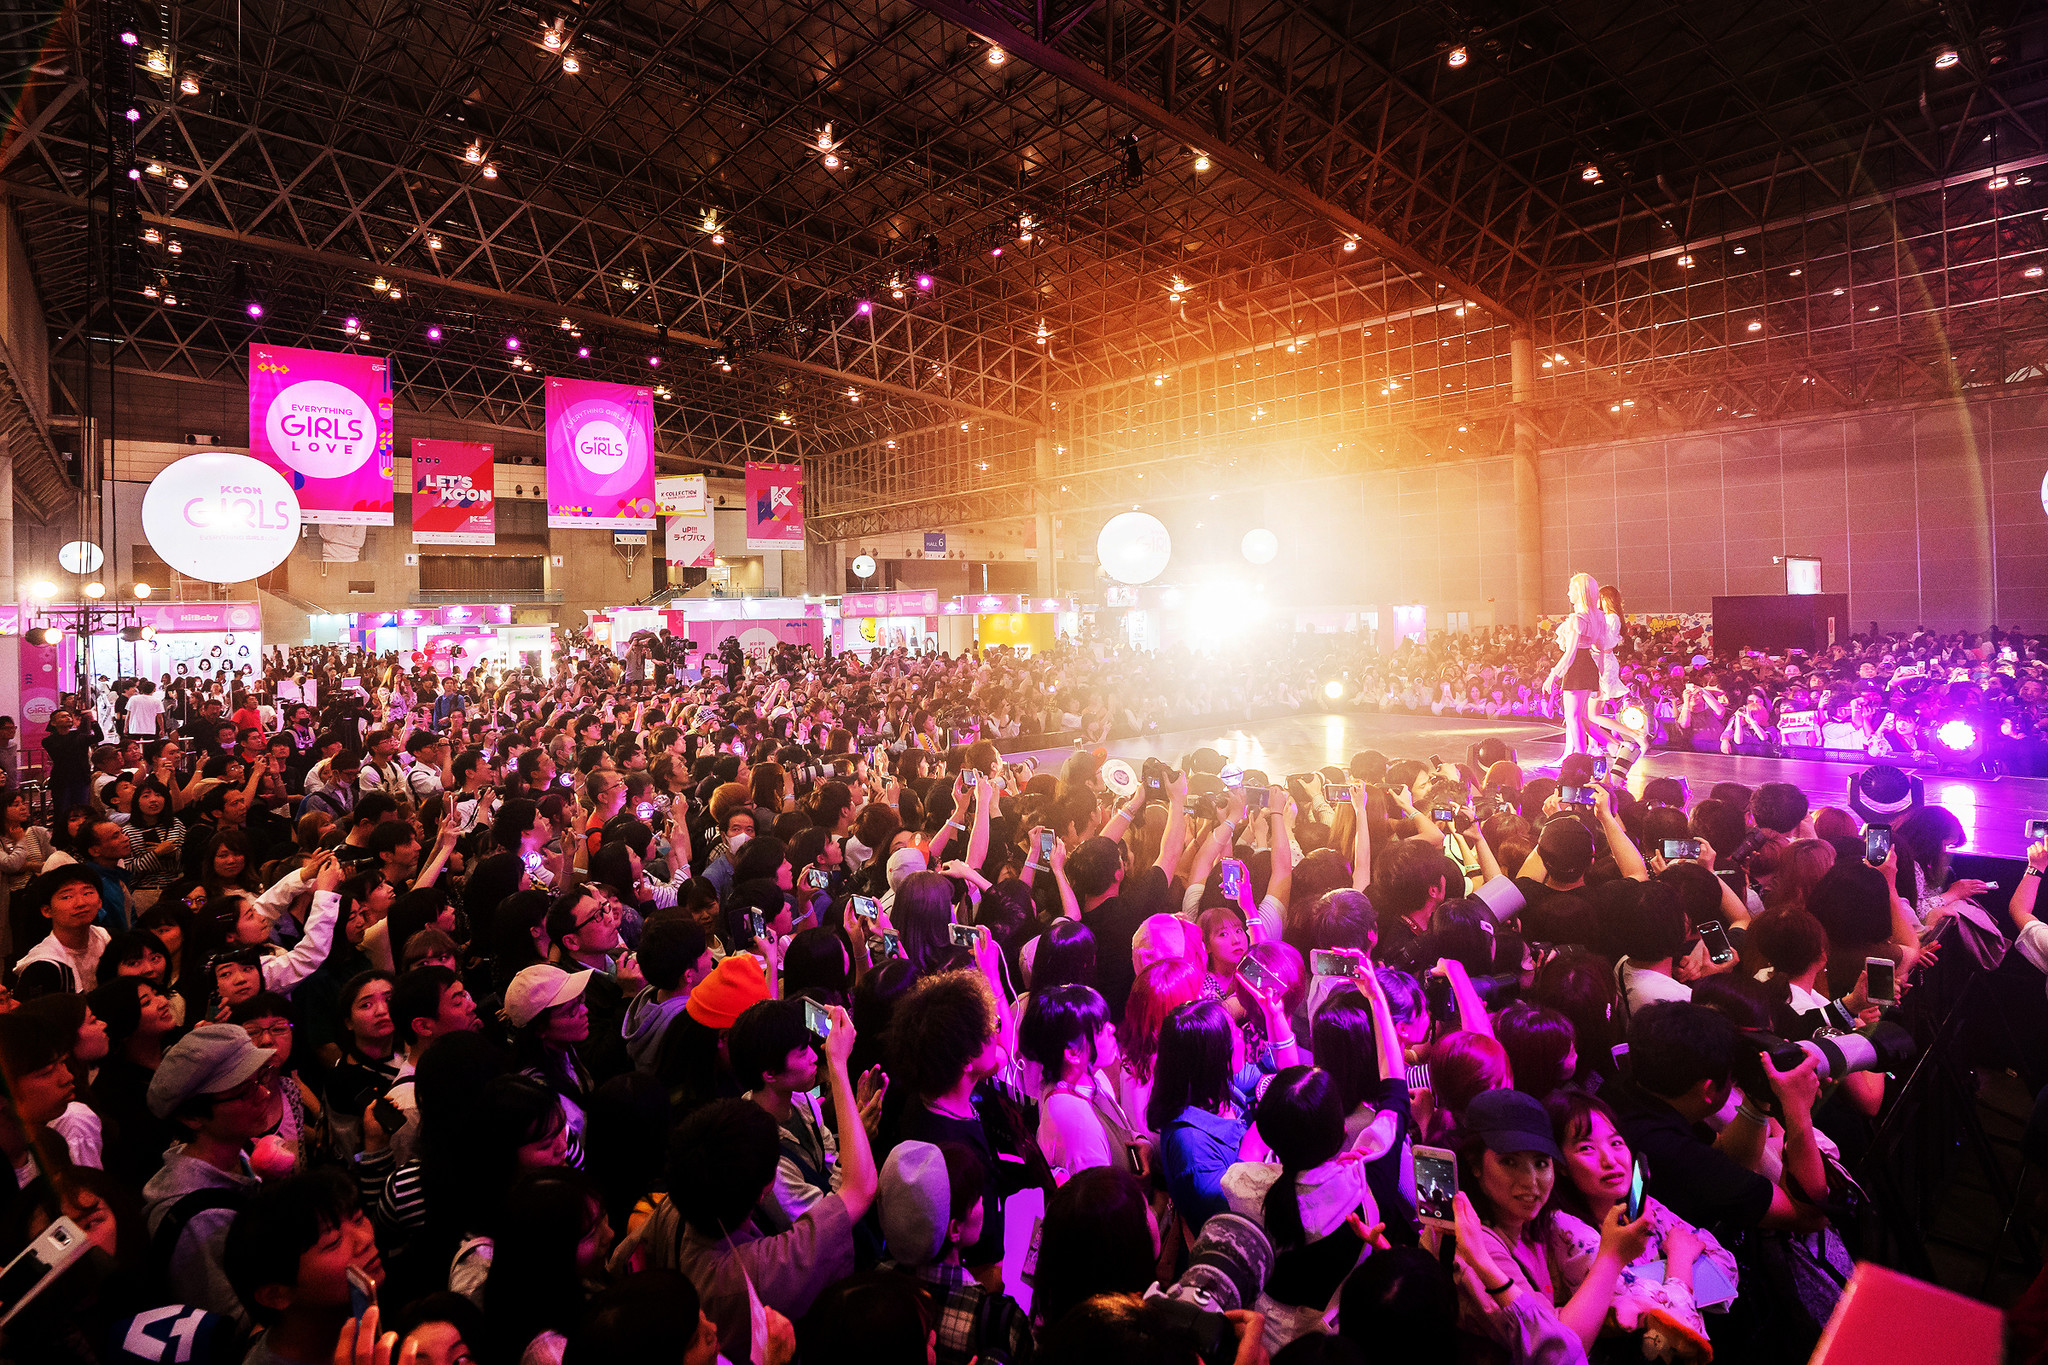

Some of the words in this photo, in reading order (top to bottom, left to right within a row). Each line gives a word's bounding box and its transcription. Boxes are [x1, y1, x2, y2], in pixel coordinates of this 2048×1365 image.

[291, 404, 353, 416] EVERYTHING
[566, 408, 604, 429] EVERYTHING
[605, 409, 625, 422] GIRLS
[281, 414, 363, 441] GIRLS
[292, 441, 353, 455] LOVE
[580, 441, 623, 457] GIRLS
[425, 474, 473, 489] LET'S
[220, 485, 262, 495] KCON
[441, 488, 492, 502] KCON
[183, 497, 290, 530] GIRLS
[938, 538, 944, 547] 6
[27, 706, 54, 714] GIRLS
